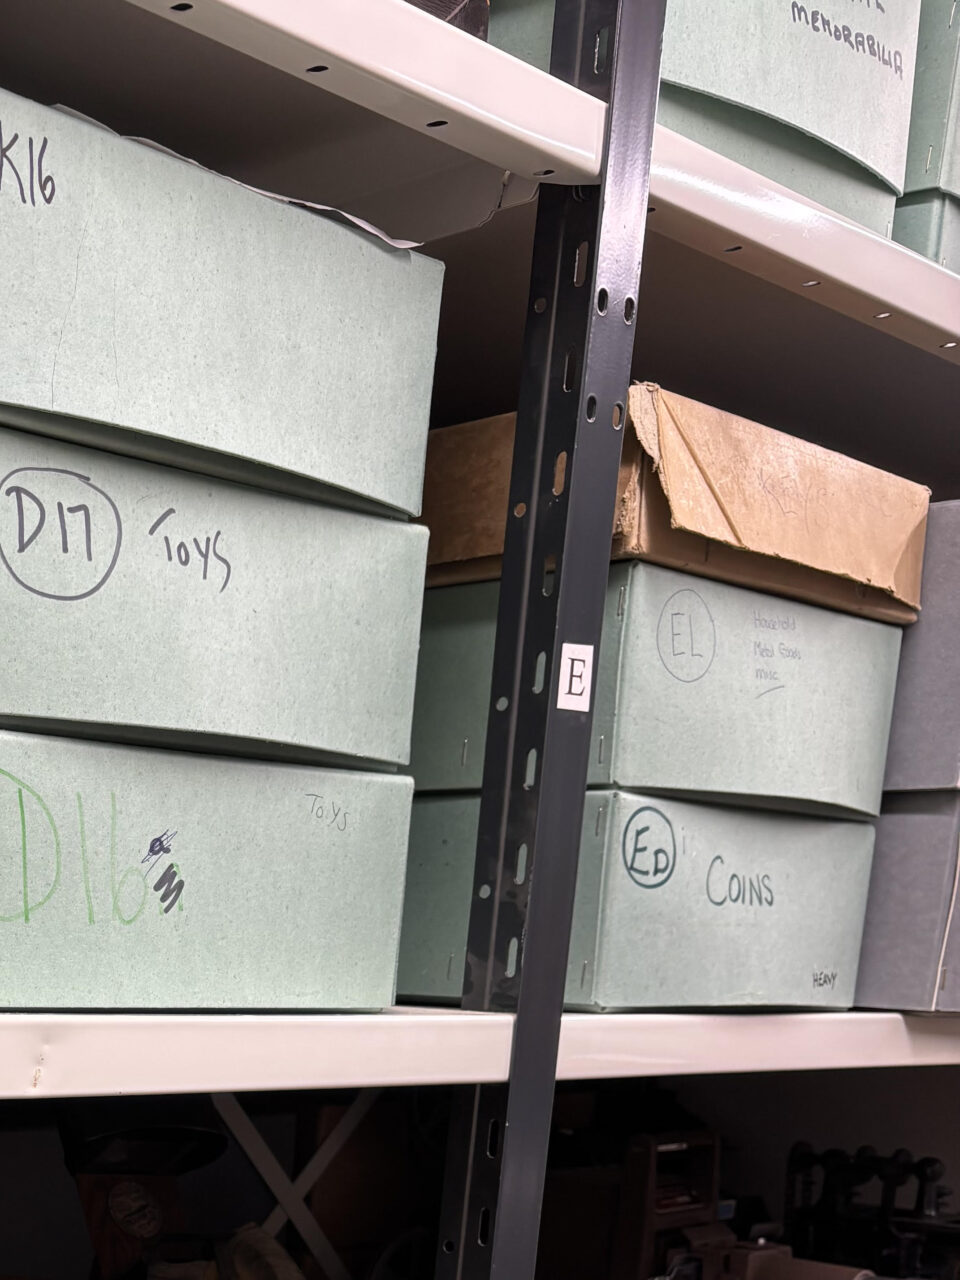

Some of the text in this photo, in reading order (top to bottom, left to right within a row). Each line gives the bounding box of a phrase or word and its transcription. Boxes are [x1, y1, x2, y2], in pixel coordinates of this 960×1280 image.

[791, 1, 903, 80] MEMORABILIA
[5, 486, 93, 562] D17
[565, 657, 586, 698] E
[706, 855, 775, 907] COINS
[812, 971, 838, 989] HEAVY
